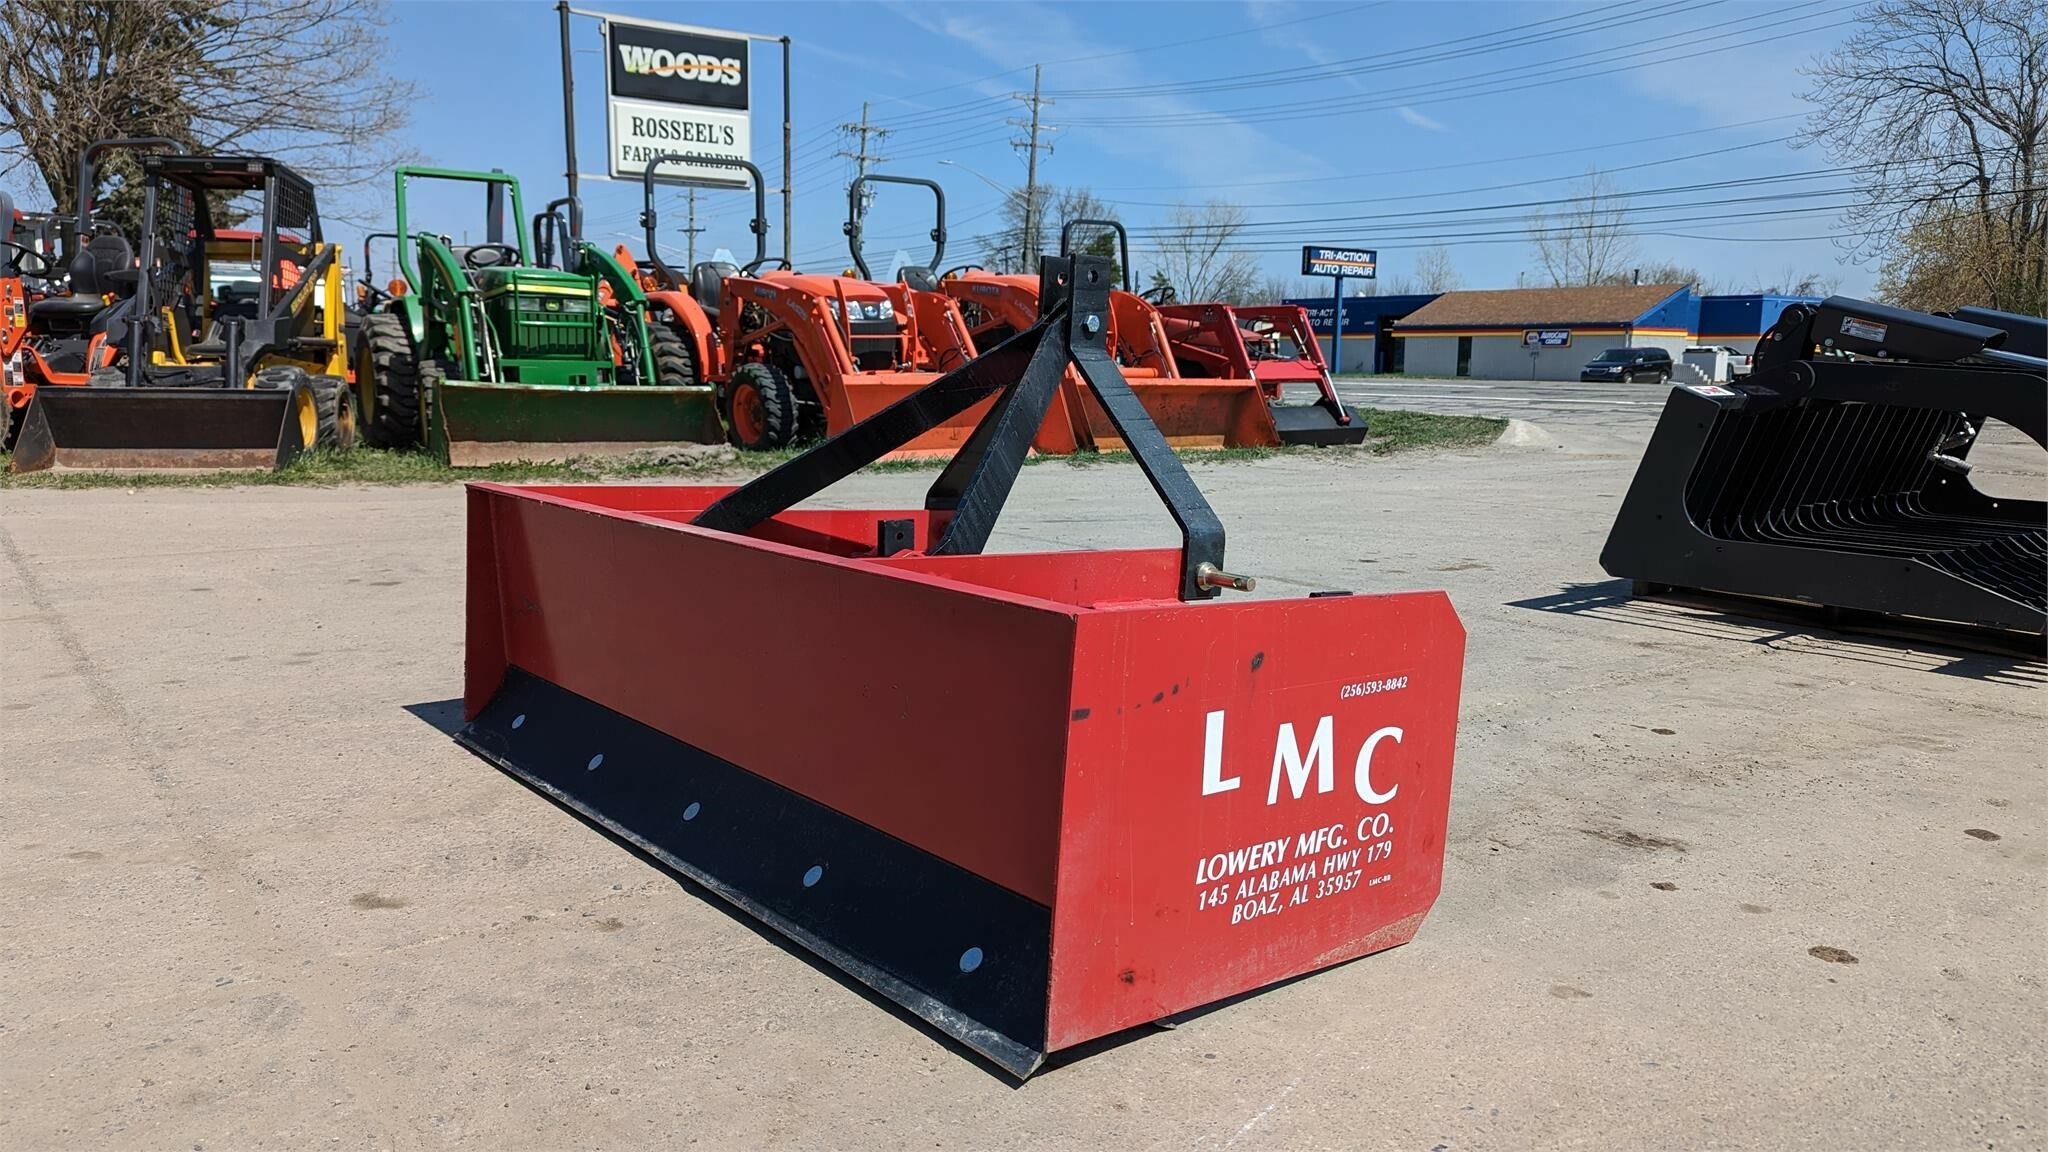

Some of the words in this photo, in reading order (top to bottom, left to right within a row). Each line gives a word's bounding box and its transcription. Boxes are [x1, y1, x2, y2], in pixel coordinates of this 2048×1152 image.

[619, 44, 742, 86] WOODS
[632, 117, 734, 146] ROSSEEL'S
[621, 145, 665, 164] FARM
[1312, 264, 1339, 274] AUTO
[1341, 266, 1373, 275] REPAIR
[1319, 250, 1369, 262] TRI-ACTION
[1340, 676, 1408, 700] (256)593-8842
[1195, 837, 1291, 885] LOWERY
[1294, 823, 1348, 859] MFG.
[1357, 812, 1394, 841] CO.
[1199, 884, 1229, 911] 145
[1235, 860, 1316, 901] ALABAMA
[1322, 848, 1362, 876] HWY
[1367, 840, 1392, 864] 179
[1231, 893, 1283, 925] BOAZ,
[1289, 885, 1309, 908] AL
[1315, 869, 1362, 899] 35957
